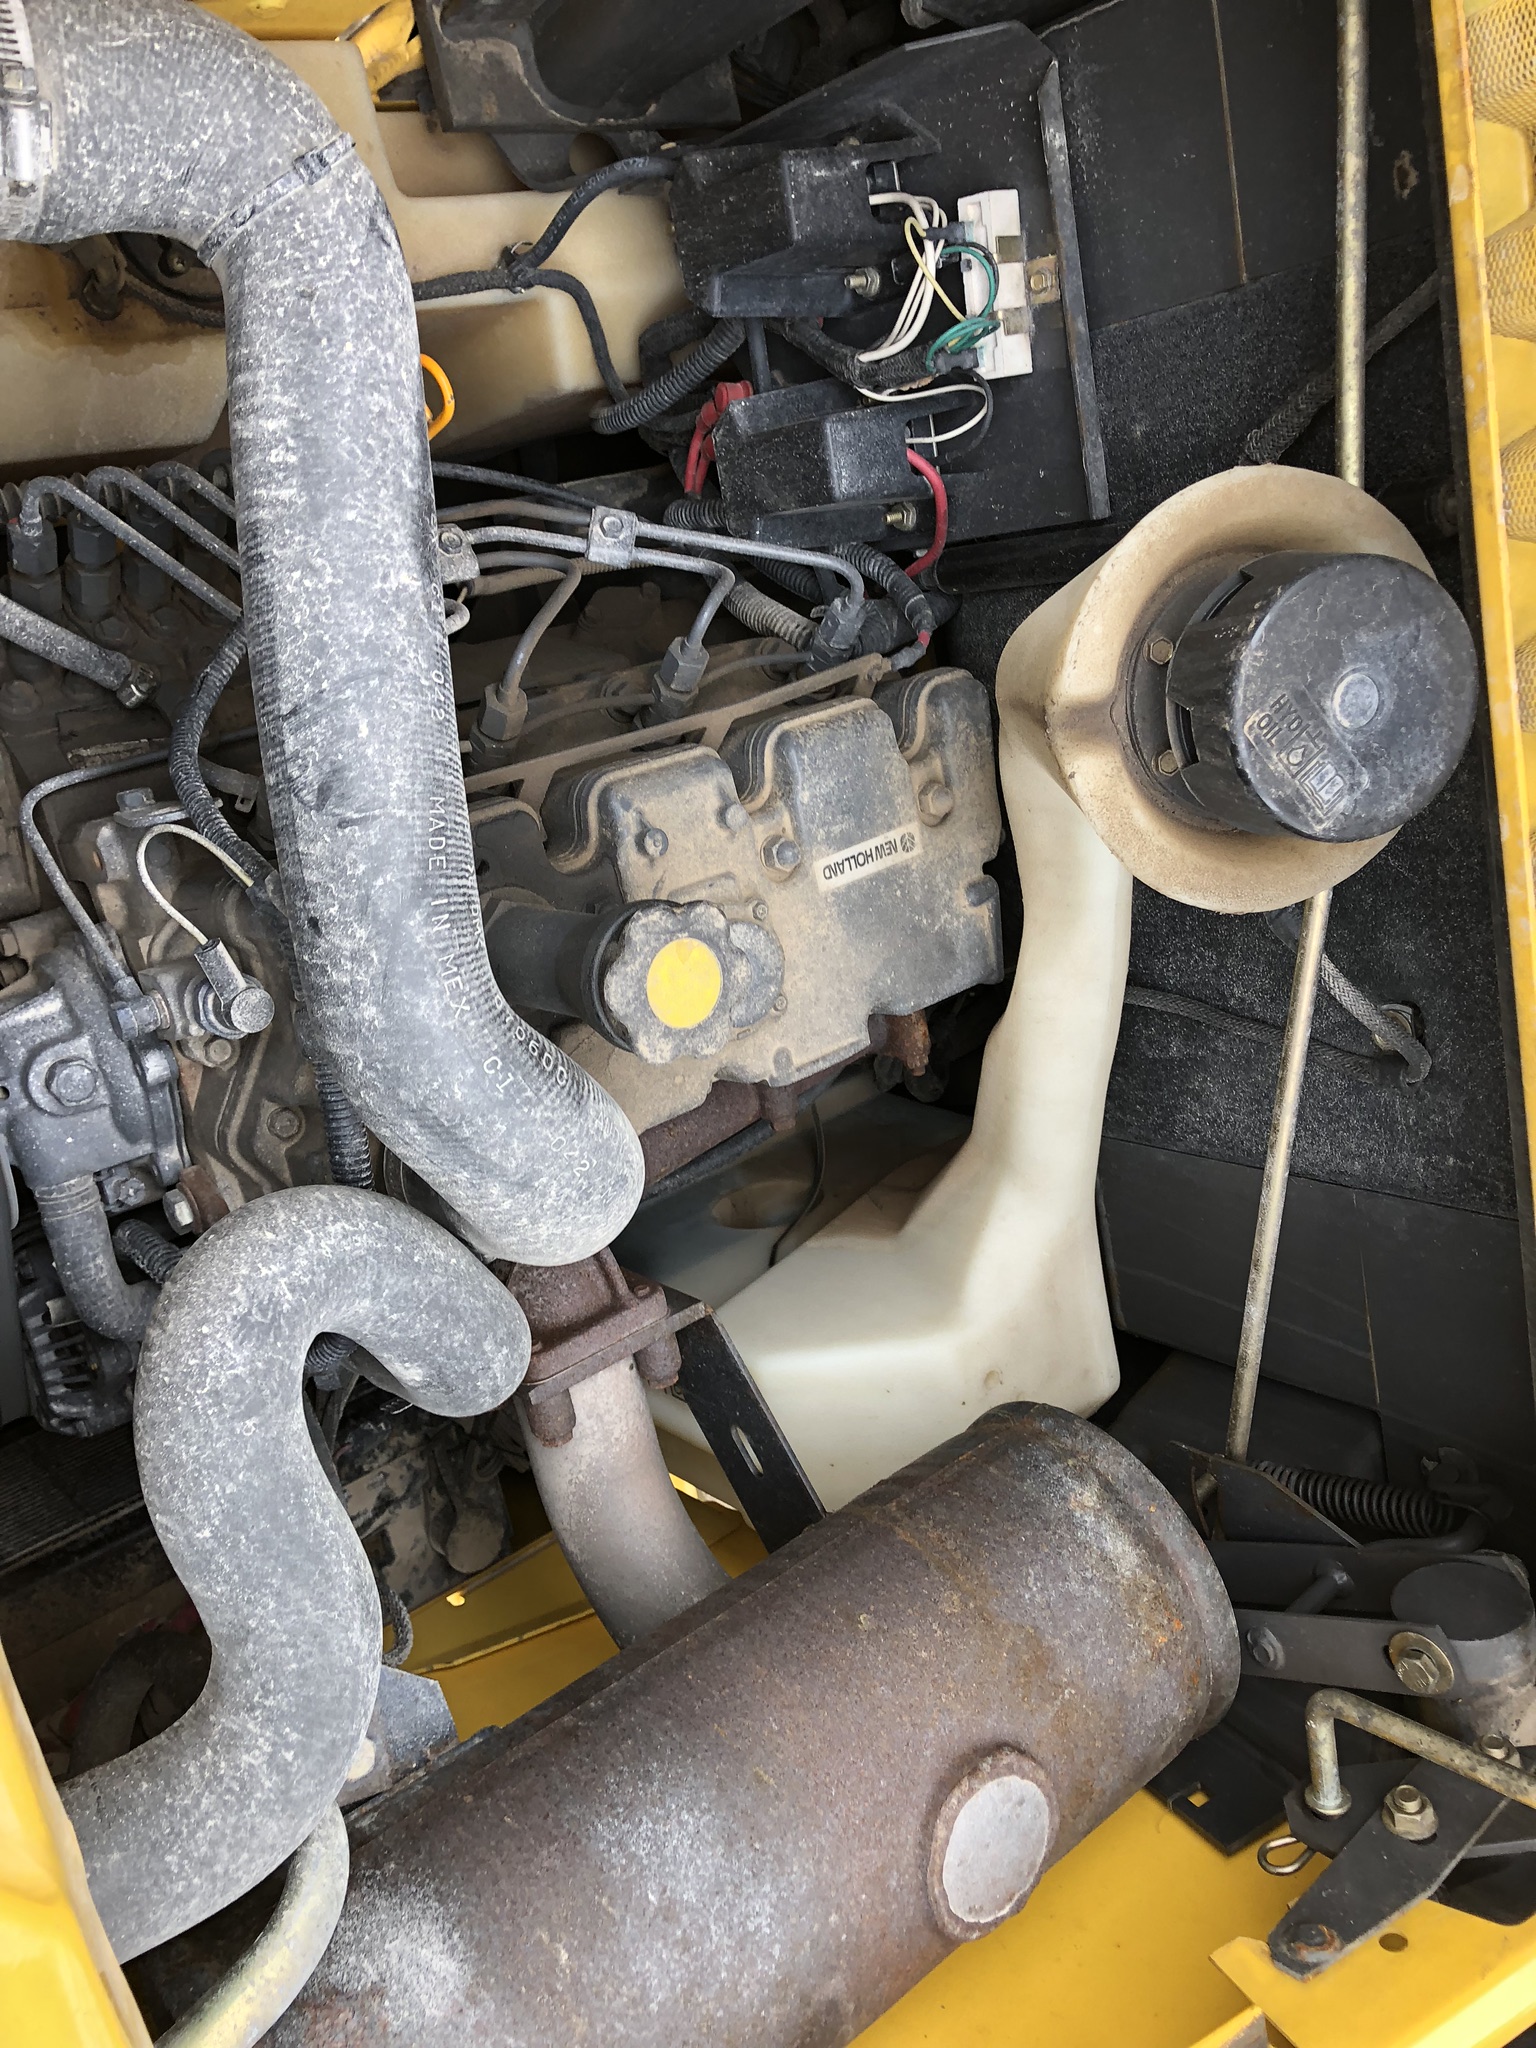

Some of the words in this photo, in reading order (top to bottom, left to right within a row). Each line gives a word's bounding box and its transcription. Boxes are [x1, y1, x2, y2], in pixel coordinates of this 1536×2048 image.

[1256, 712, 1283, 747] OIL
[1269, 692, 1303, 732] HYD
[428, 796, 446, 871] MADE
[874, 837, 899, 861] NEW
[822, 847, 875, 880] HOLLAND
[430, 897, 450, 932] IN
[439, 952, 471, 1019] MEX
